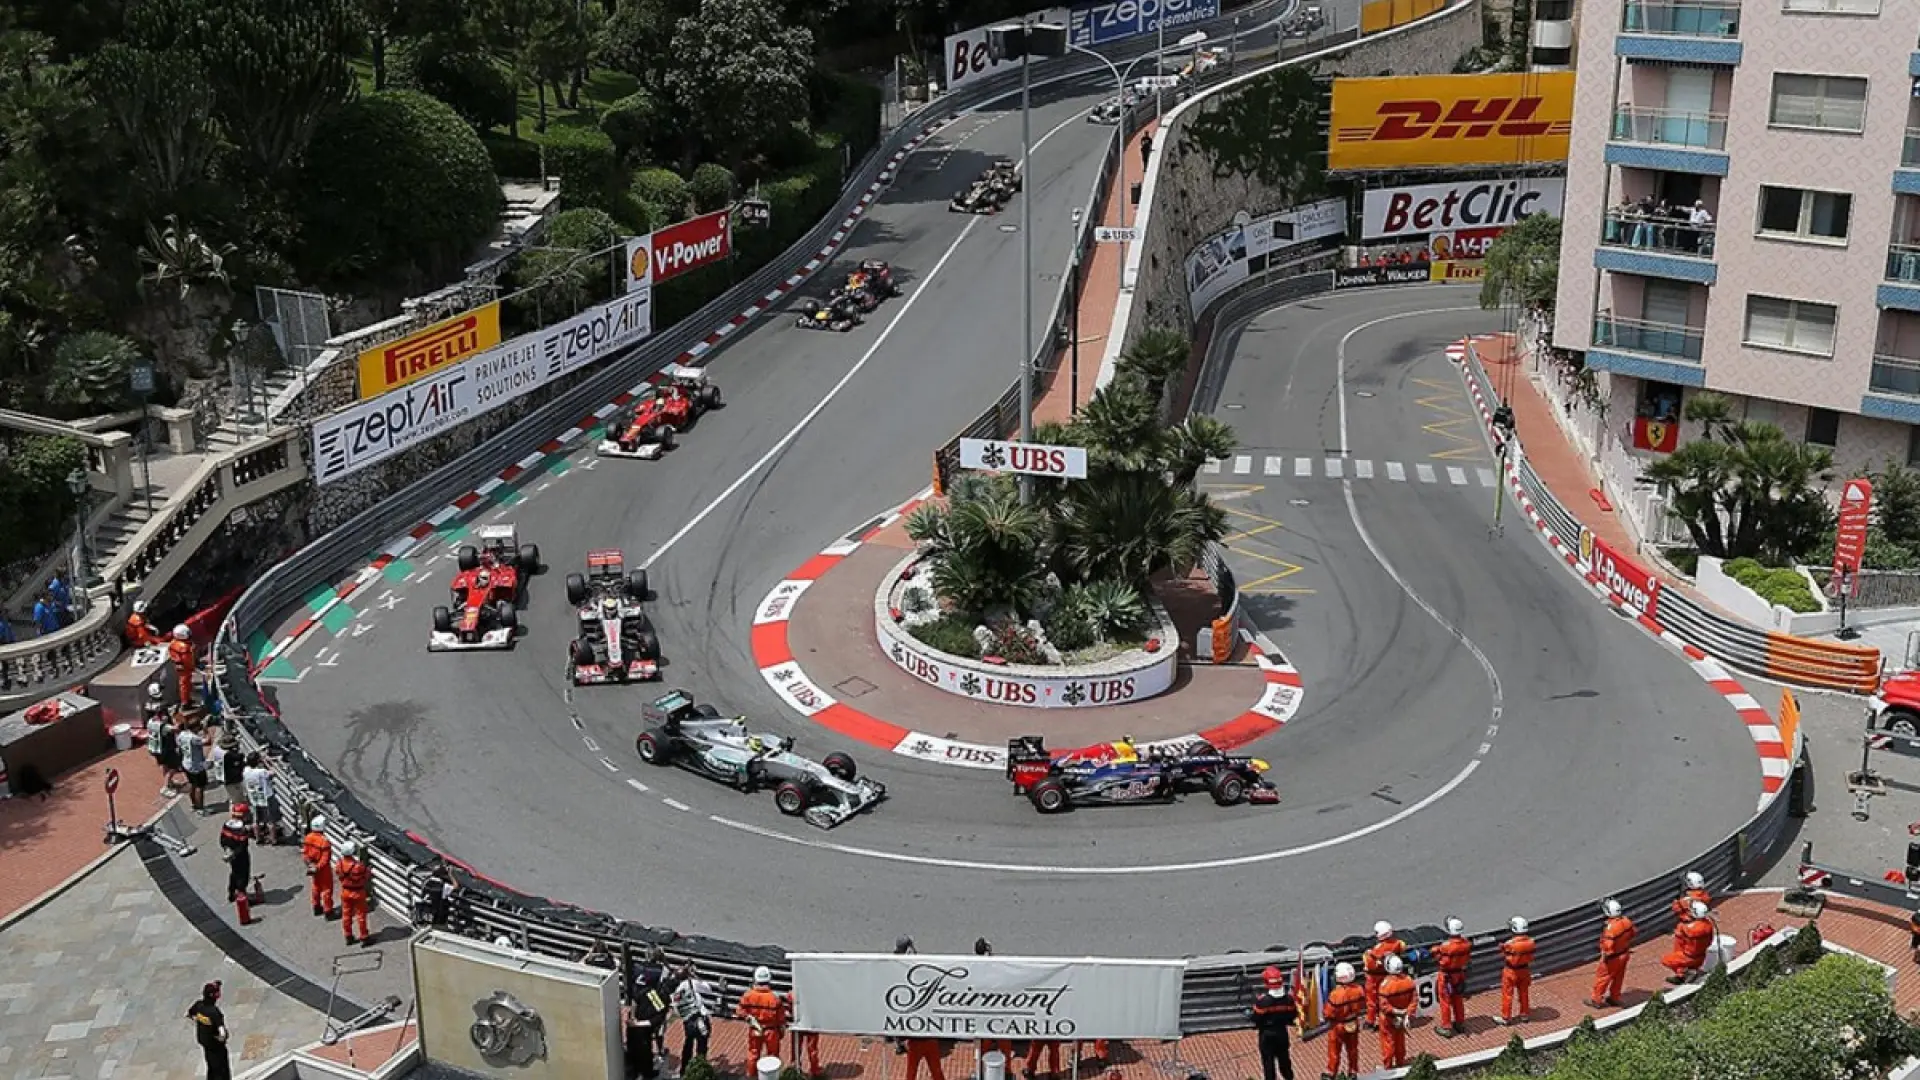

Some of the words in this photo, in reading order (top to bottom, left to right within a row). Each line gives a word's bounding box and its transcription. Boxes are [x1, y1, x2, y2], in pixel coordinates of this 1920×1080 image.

[1371, 97, 1551, 140] DHL
[1383, 181, 1541, 233] BetClic
[1112, 230, 1136, 240] UBS
[656, 234, 723, 274] V-Power
[1386, 269, 1428, 281] WALKER
[384, 316, 478, 386] PIRELLI
[475, 351, 519, 383] PRIVATE
[520, 344, 537, 365] JET
[477, 366, 537, 404] SOLUTIONS
[1009, 447, 1066, 473] UBS
[1595, 547, 1650, 612] V-Power
[905, 651, 940, 683] UBS
[787, 682, 821, 708] UBS
[985, 679, 1037, 703] UBS
[1090, 677, 1135, 700] UBS
[945, 745, 997, 764] UBS
[1016, 764, 1049, 773] TOTAL
[885, 963, 1072, 1016] Fairmont
[884, 1016, 977, 1034] MONTE
[987, 1018, 1077, 1037] CARLO
